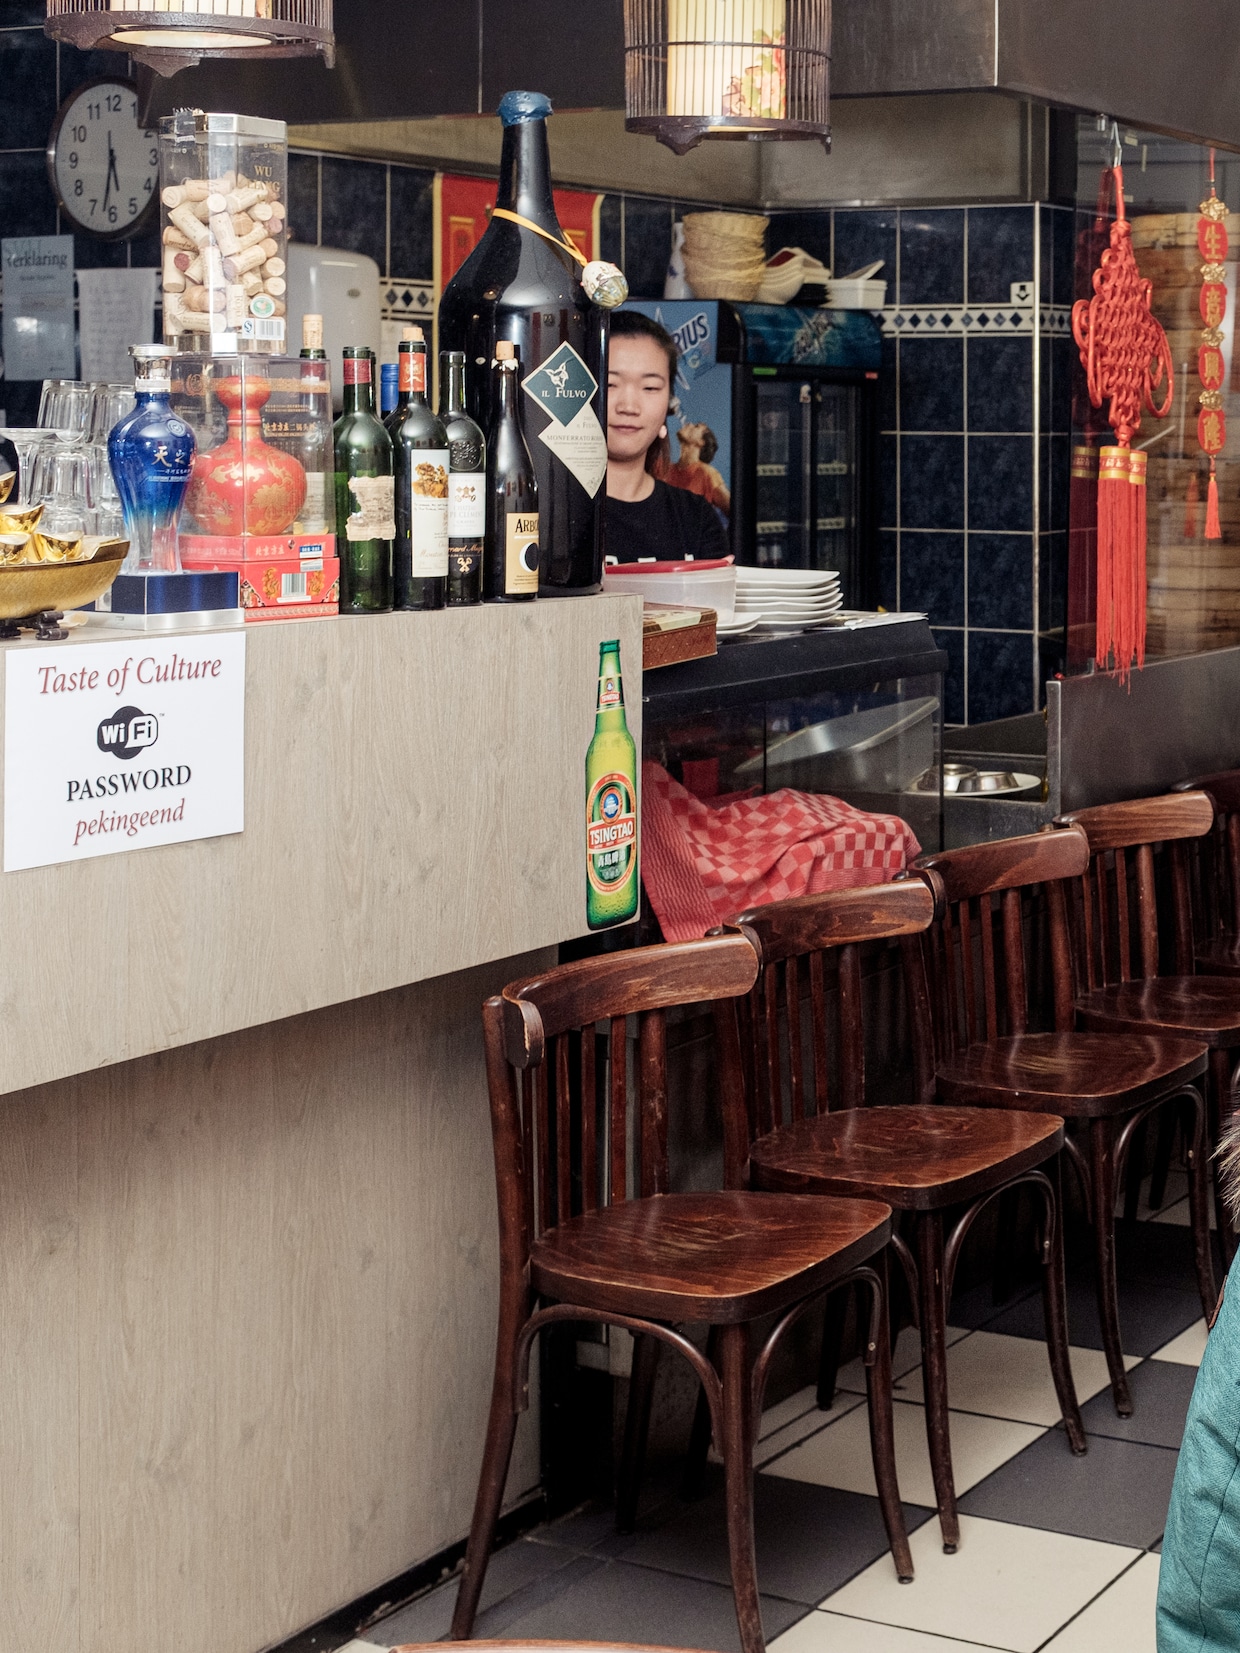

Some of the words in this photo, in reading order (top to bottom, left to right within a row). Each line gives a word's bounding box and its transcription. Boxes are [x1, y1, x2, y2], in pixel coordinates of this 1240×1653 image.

[88, 103, 101, 120] 11
[106, 94, 122, 112] 12
[72, 125, 87, 143] 10
[69, 152, 79, 169] 9
[149, 148, 159, 166] 3
[254, 165, 272, 177] WU
[74, 179, 84, 196] 8
[143, 177, 152, 194] 4
[89, 199, 97, 216] 7
[108, 206, 118, 223] 6
[128, 197, 138, 215] 5
[541, 389, 550, 398] IL
[38, 664, 99, 694] Taste
[107, 657, 133, 696] of
[136, 653, 222, 684] Culture
[66, 764, 192, 802] PASSWORD
[73, 797, 186, 846] pekingeend
[589, 820, 634, 846] TSINGTAO
